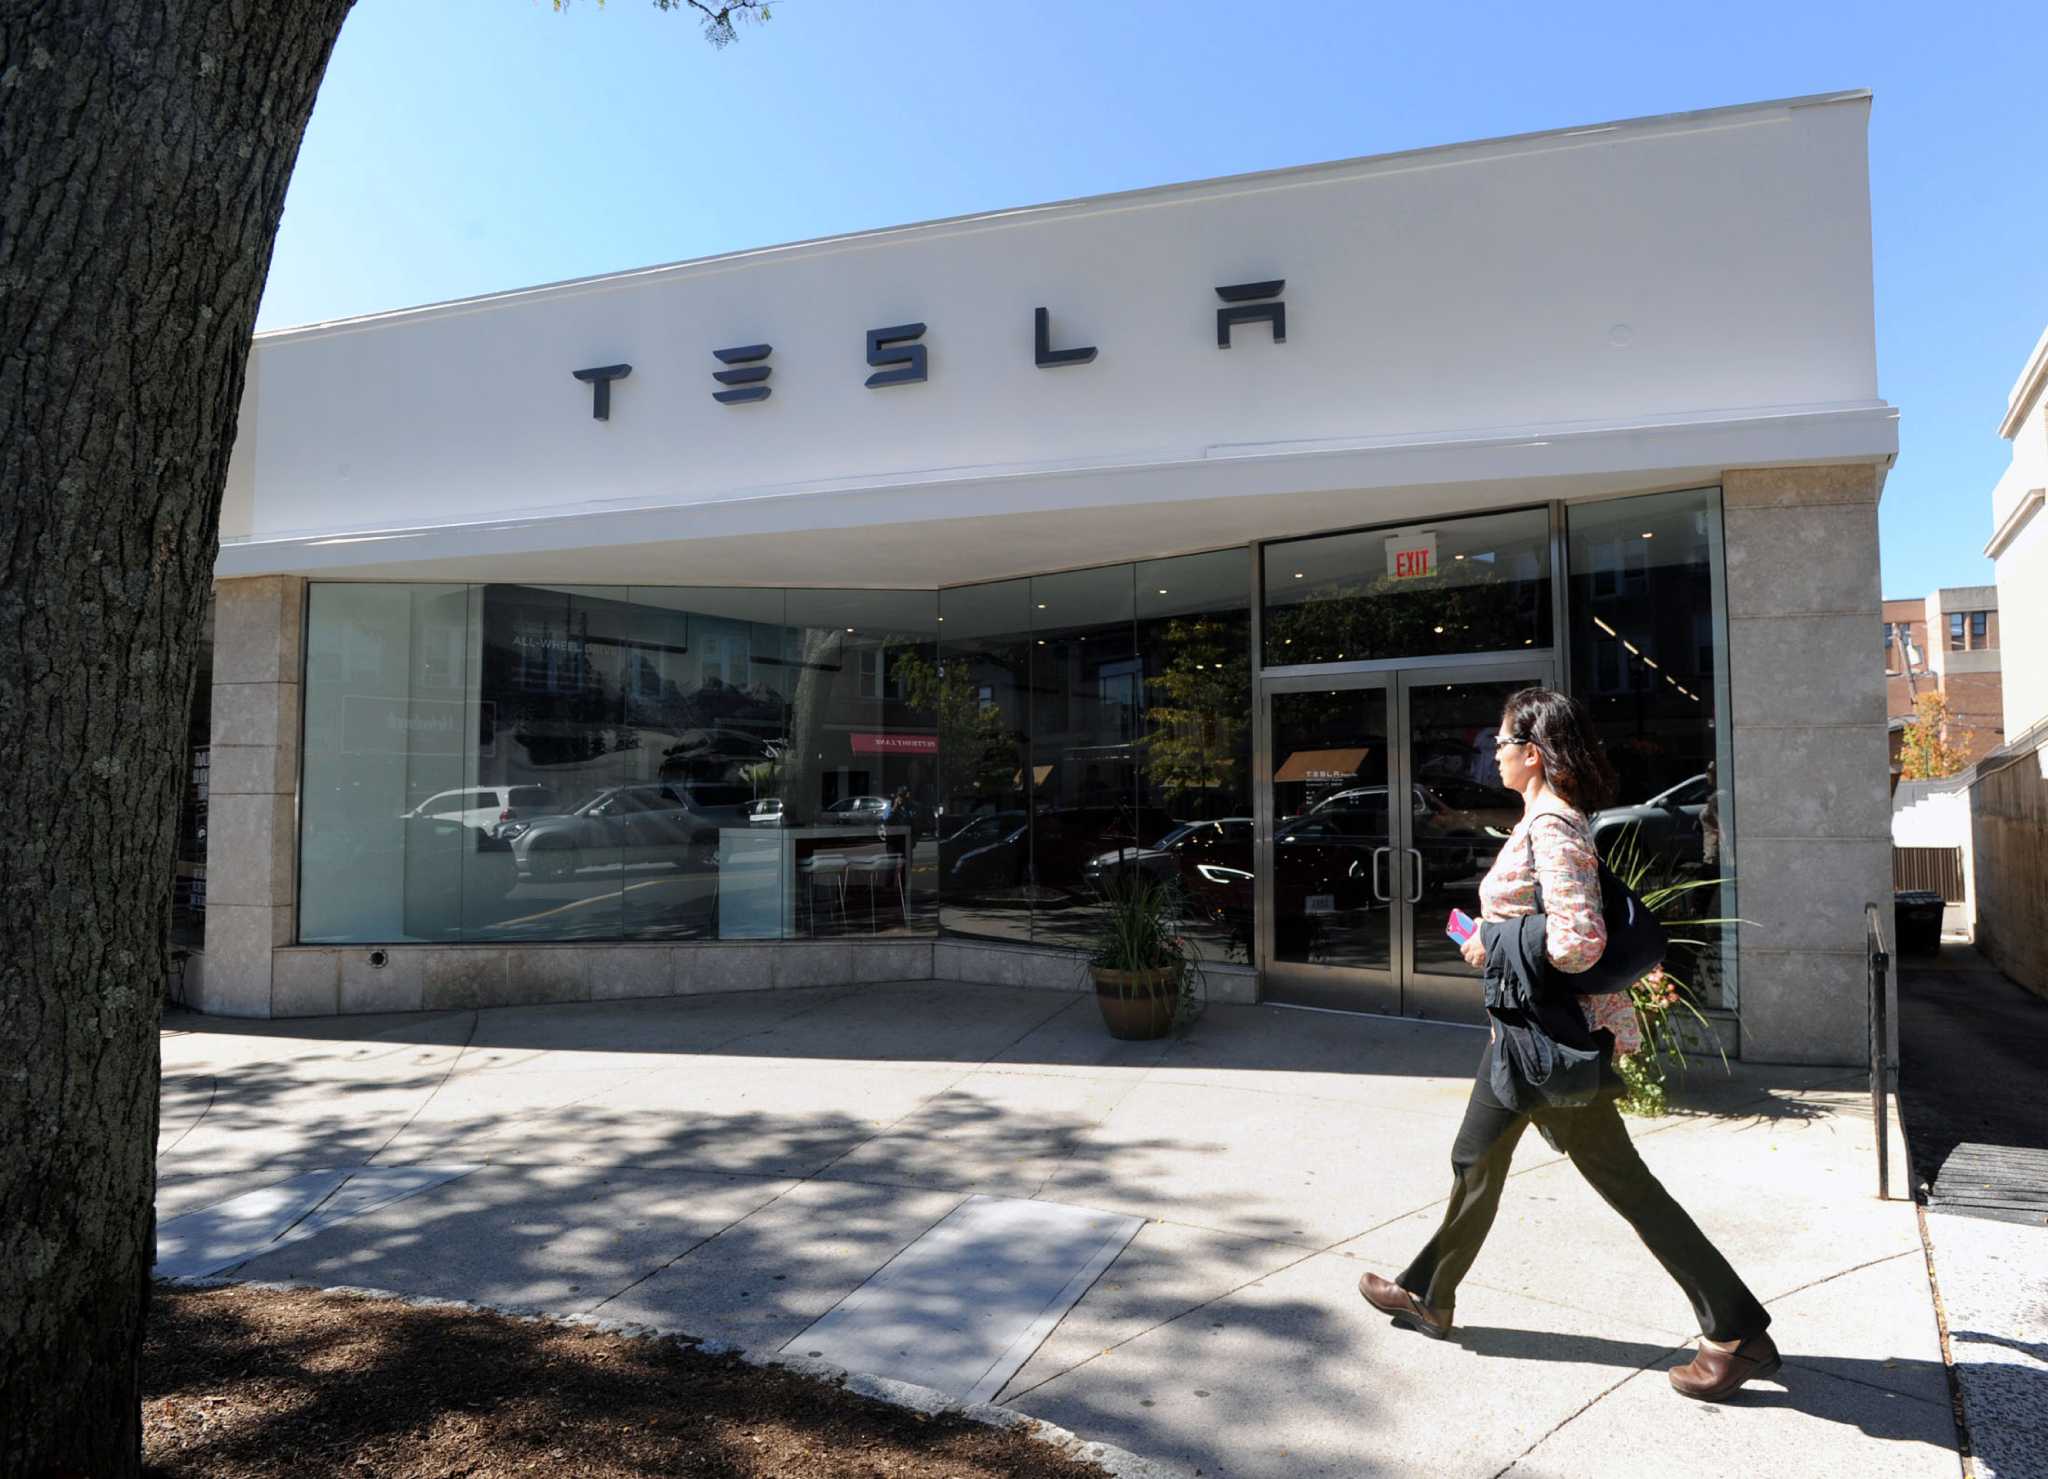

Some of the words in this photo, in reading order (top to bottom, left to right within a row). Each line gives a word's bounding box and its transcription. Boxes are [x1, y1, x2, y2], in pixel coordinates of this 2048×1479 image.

[572, 279, 1287, 422] TESLA
[1396, 549, 1429, 577] EXIT
[512, 635, 583, 654] ALL-WHEEL
